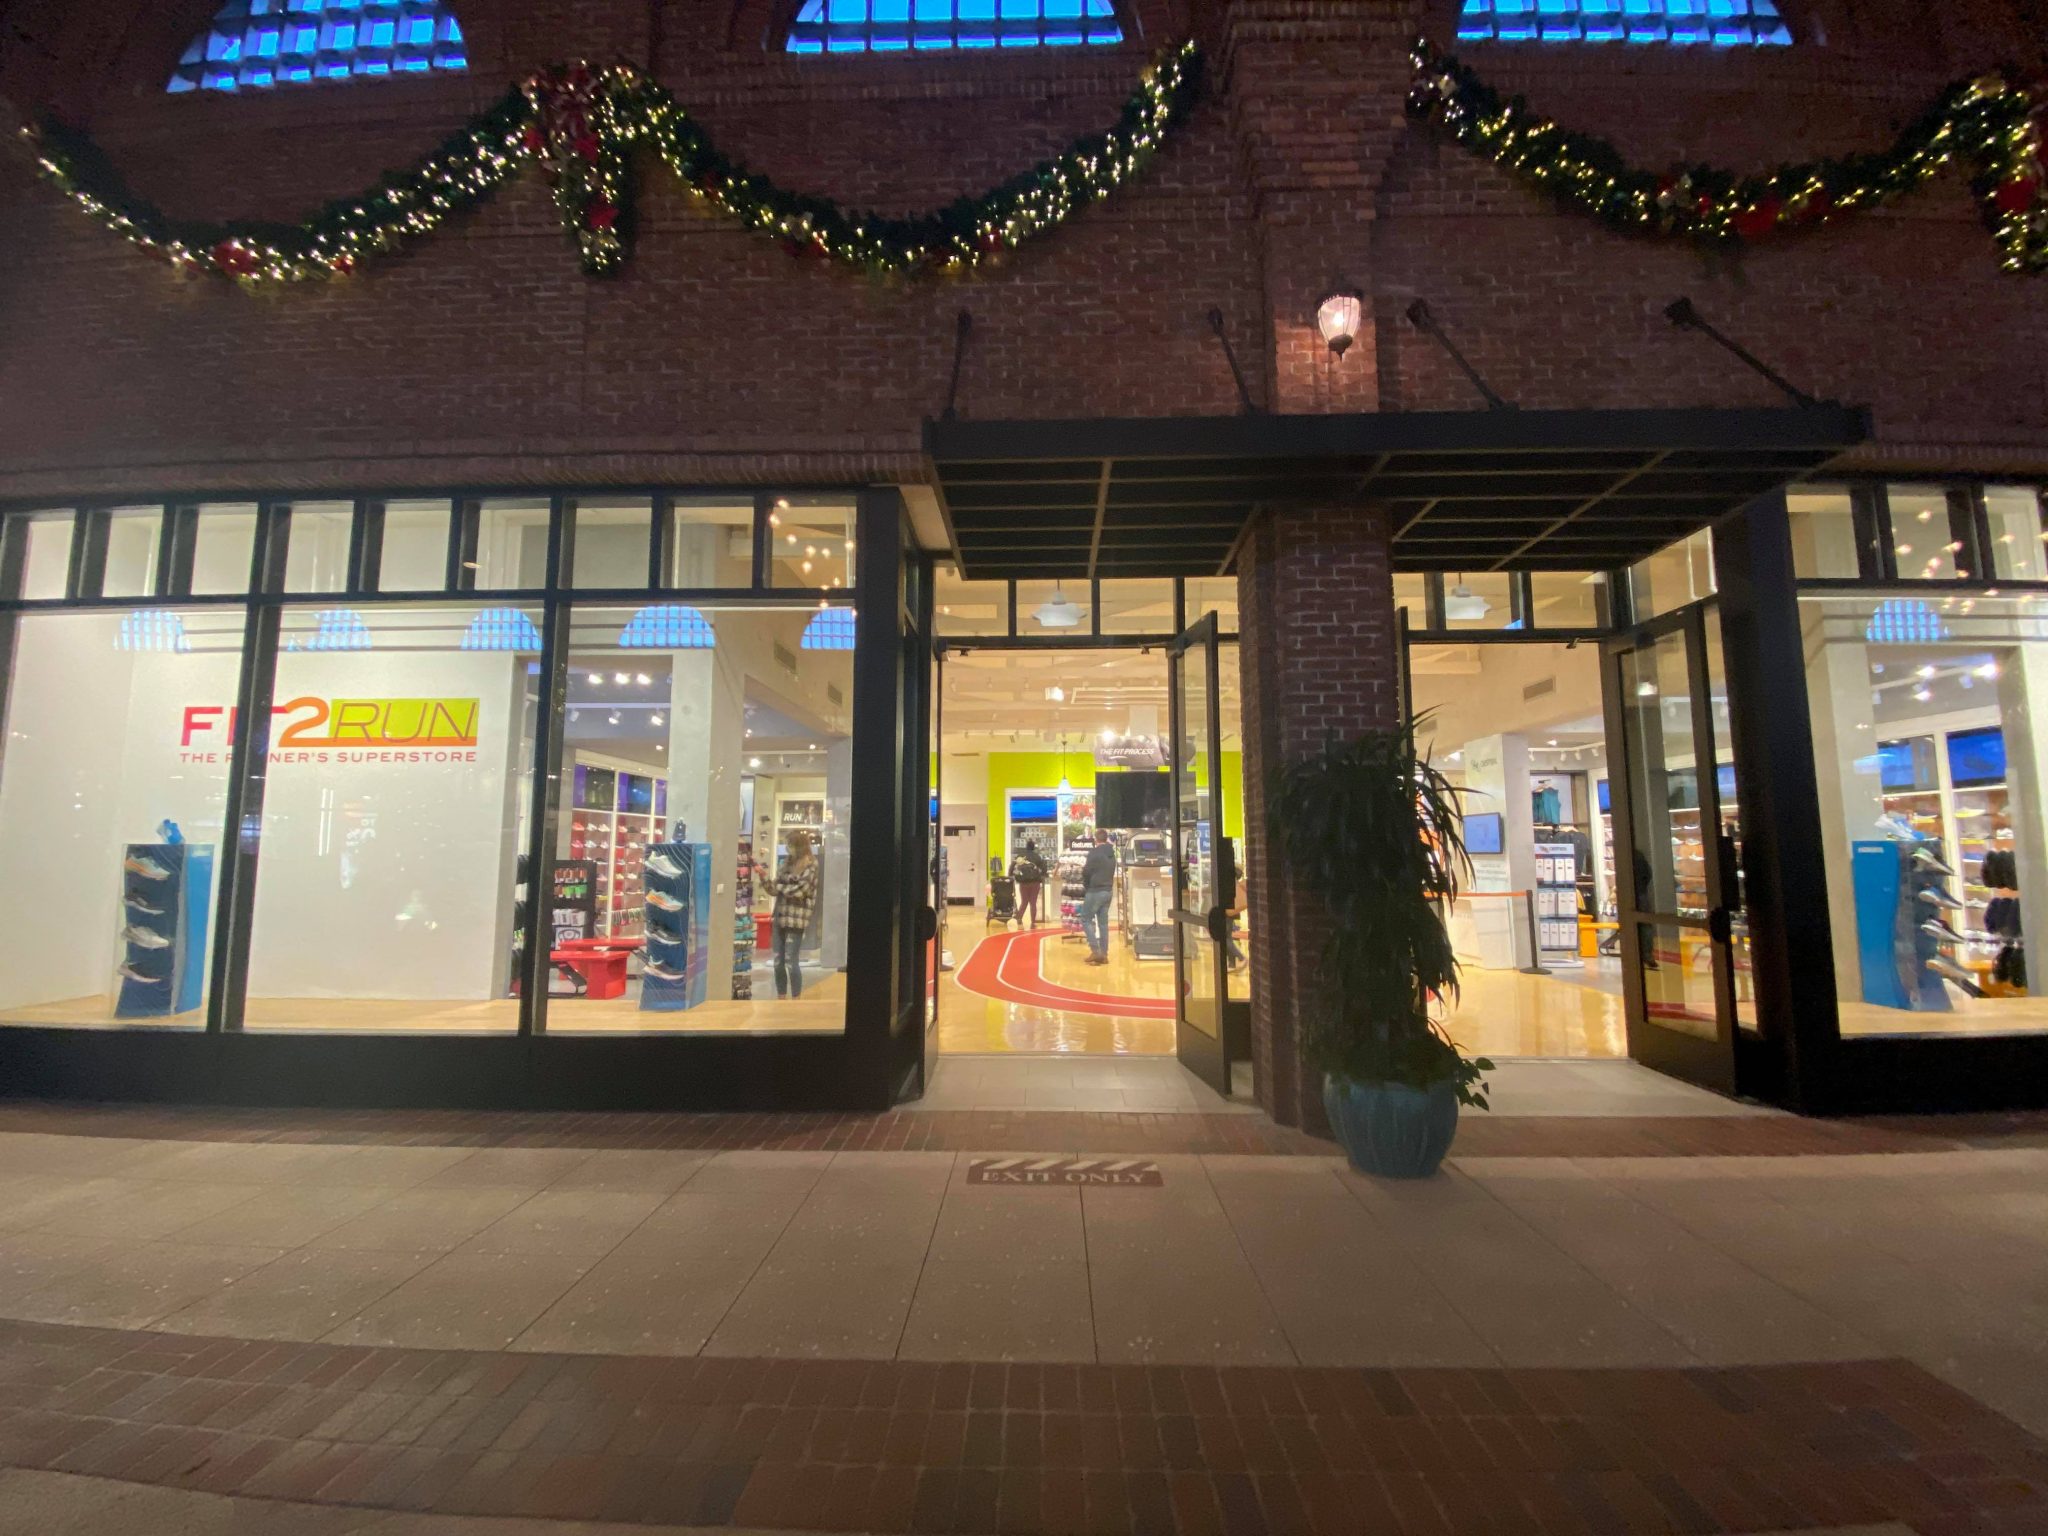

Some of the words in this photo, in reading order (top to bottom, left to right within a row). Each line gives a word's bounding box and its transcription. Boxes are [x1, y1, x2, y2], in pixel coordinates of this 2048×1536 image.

[180, 753, 217, 763] THE
[225, 752, 329, 763] RNER'S
[337, 751, 476, 763] SUPERSTORE
[783, 812, 802, 821] RUN
[982, 1171, 1056, 1182] EXIT
[1065, 1172, 1145, 1183] ONLY
